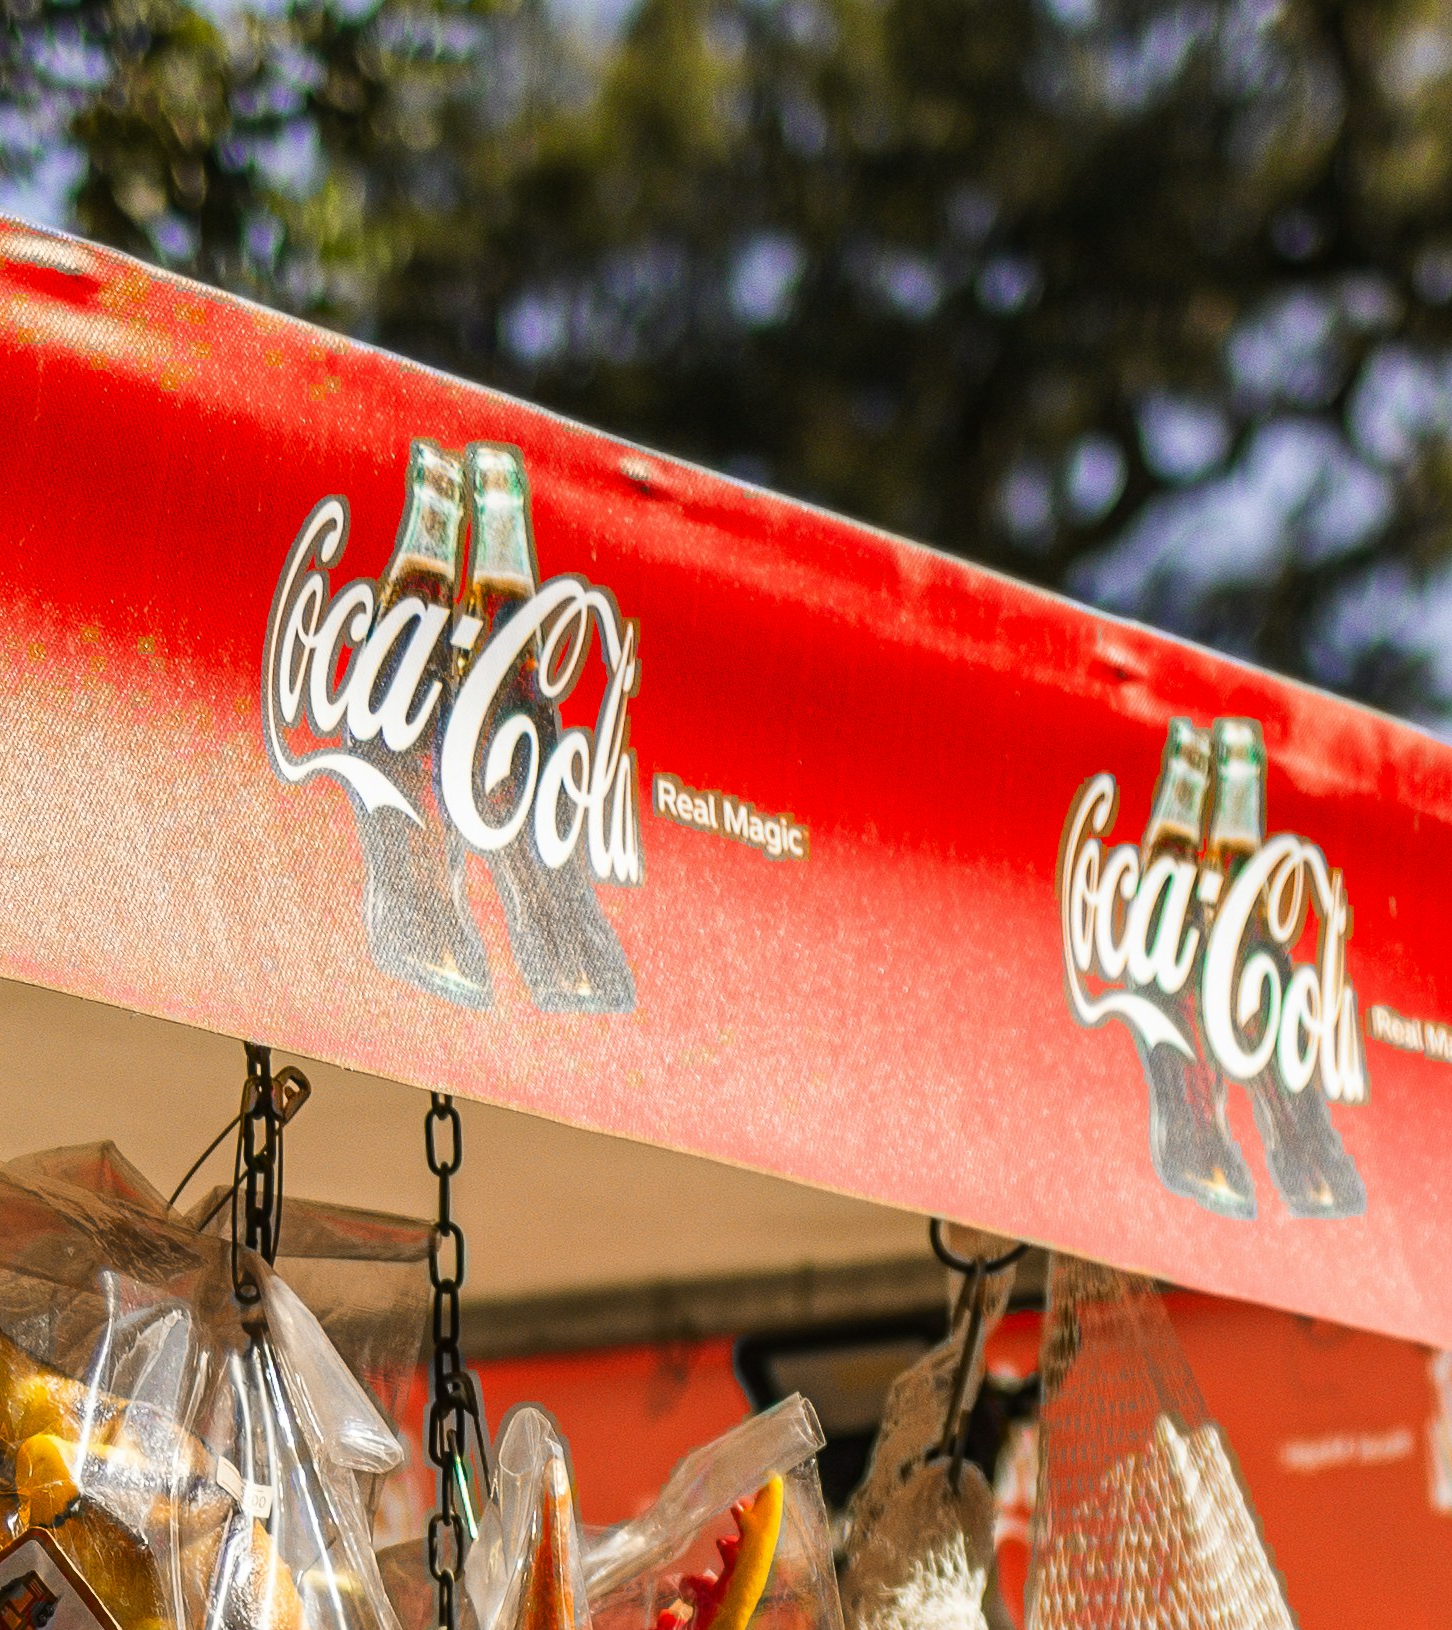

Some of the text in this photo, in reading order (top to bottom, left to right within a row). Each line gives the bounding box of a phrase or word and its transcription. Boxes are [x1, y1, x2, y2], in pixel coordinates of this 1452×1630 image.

[263, 497, 642, 884] Coca-Cola
[657, 782, 806, 857] Real Magic
[1062, 775, 1366, 1101] Coca-Cola
[1371, 1005, 1425, 1048] Real
